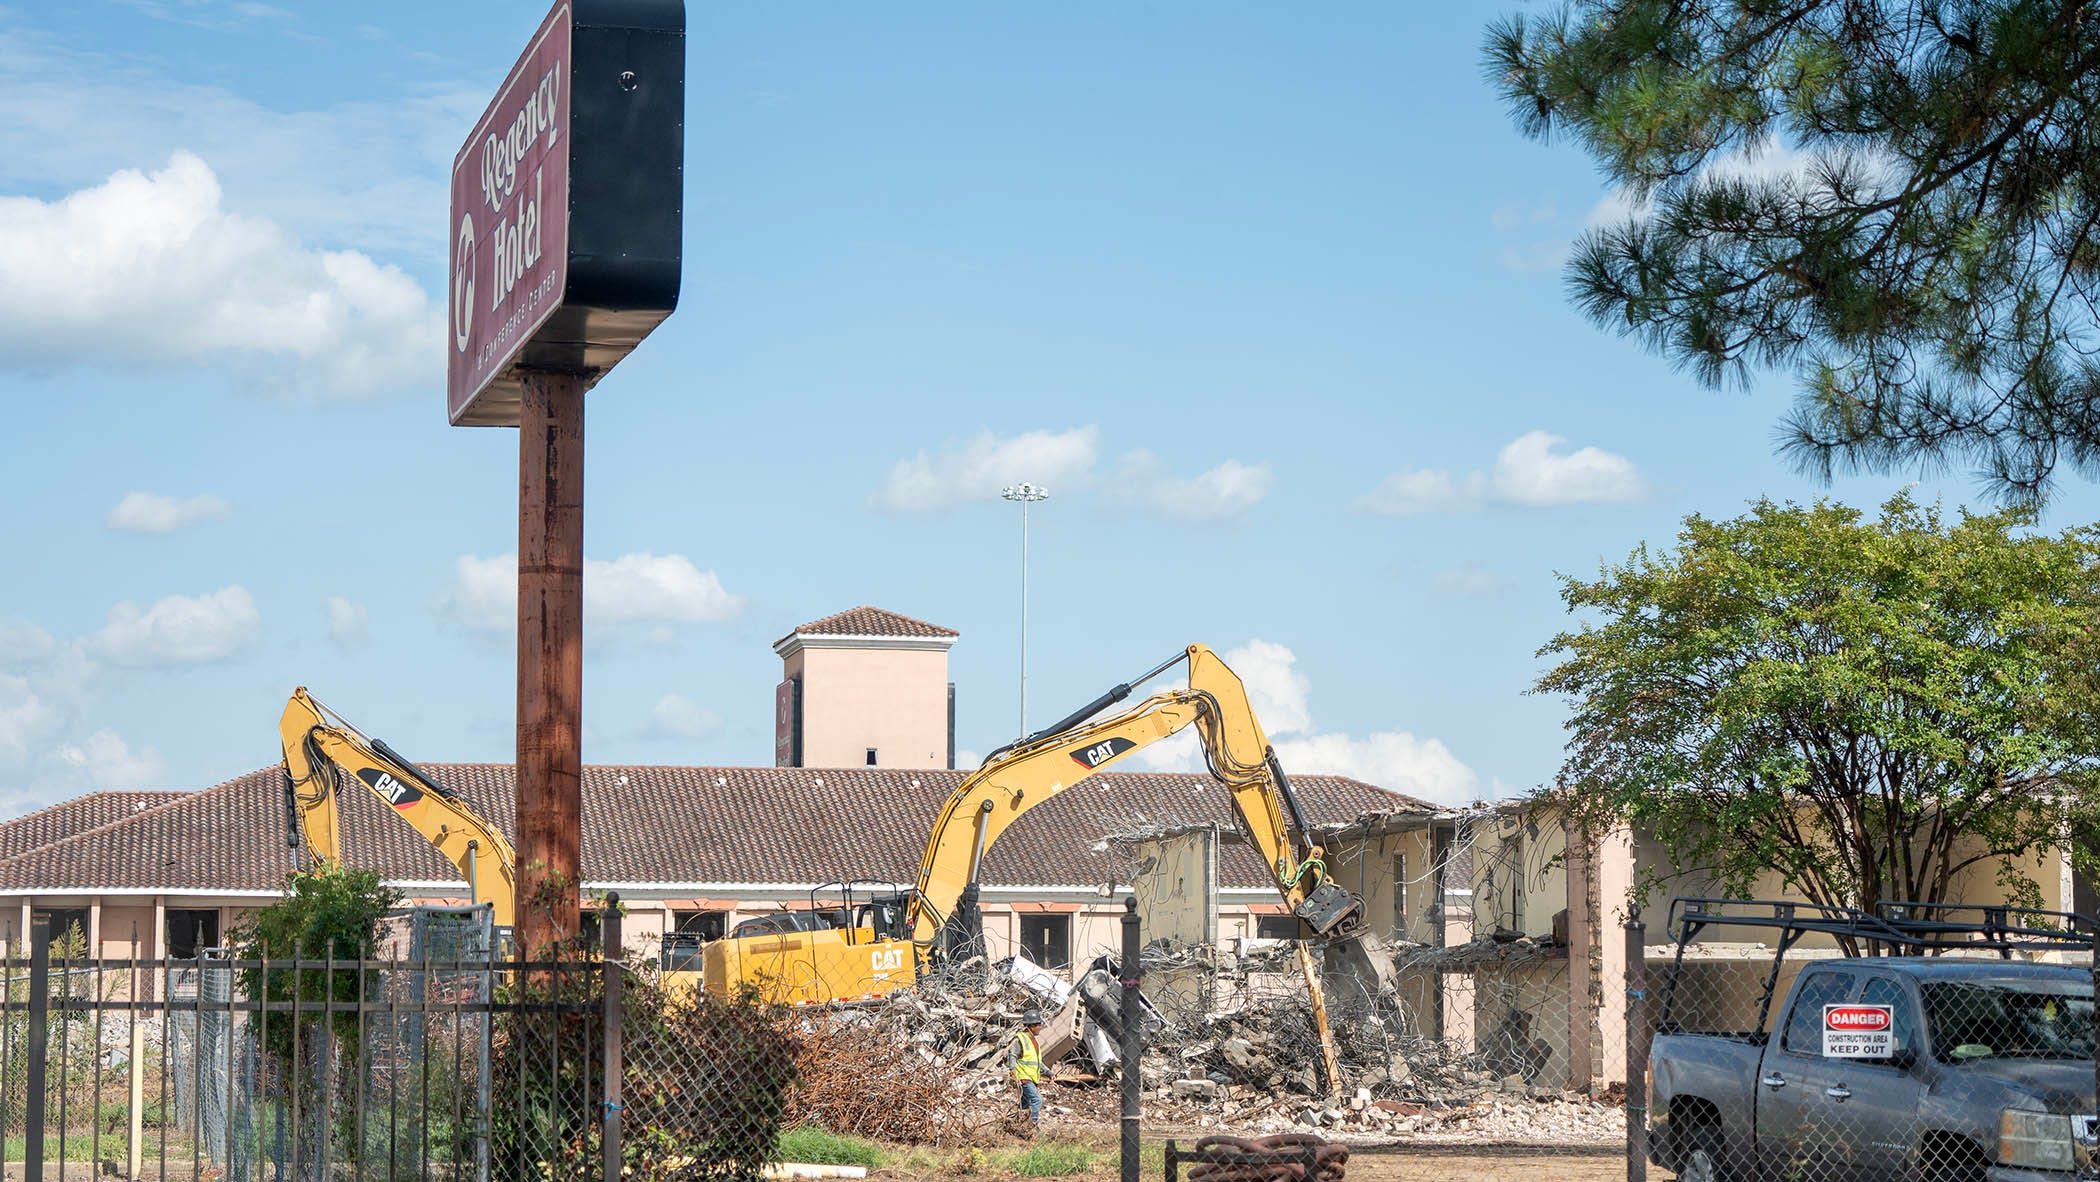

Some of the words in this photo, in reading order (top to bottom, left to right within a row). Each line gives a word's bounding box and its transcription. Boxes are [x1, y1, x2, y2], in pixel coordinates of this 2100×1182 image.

[481, 59, 561, 214] Regency
[492, 166, 543, 312] Hotel
[1087, 740, 1115, 766] CAT
[374, 772, 407, 804] CAT
[871, 949, 904, 971] CAT
[1831, 1013, 1885, 1025] DANGER
[1827, 1034, 1872, 1043] CONSTRUCTION
[1873, 1034, 1889, 1043] AREA
[1830, 1045, 1860, 1054] KEEP
[1863, 1045, 1886, 1054] OUT
